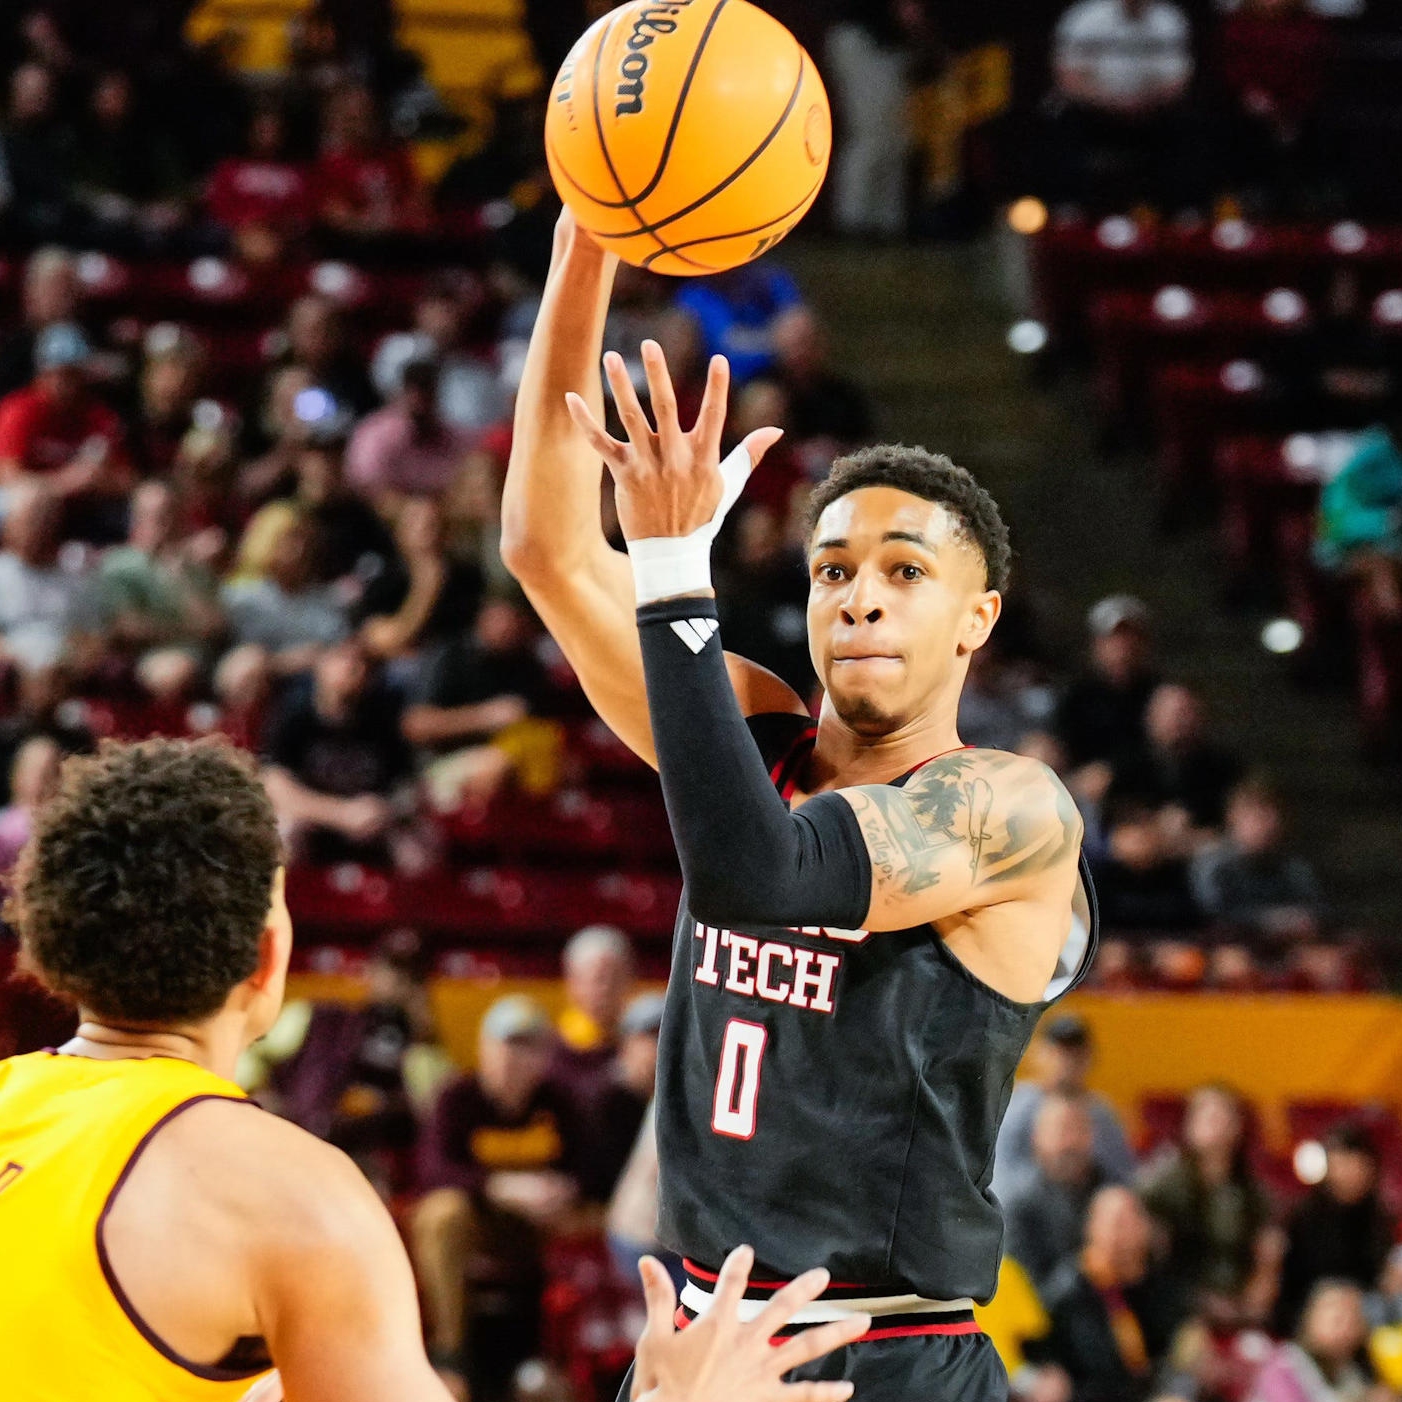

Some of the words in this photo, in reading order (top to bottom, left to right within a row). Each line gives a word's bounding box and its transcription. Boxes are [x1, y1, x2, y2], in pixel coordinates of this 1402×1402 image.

[614, 0, 695, 118] ilson
[695, 922, 840, 1013] TECH
[710, 1017, 768, 1140] 0
